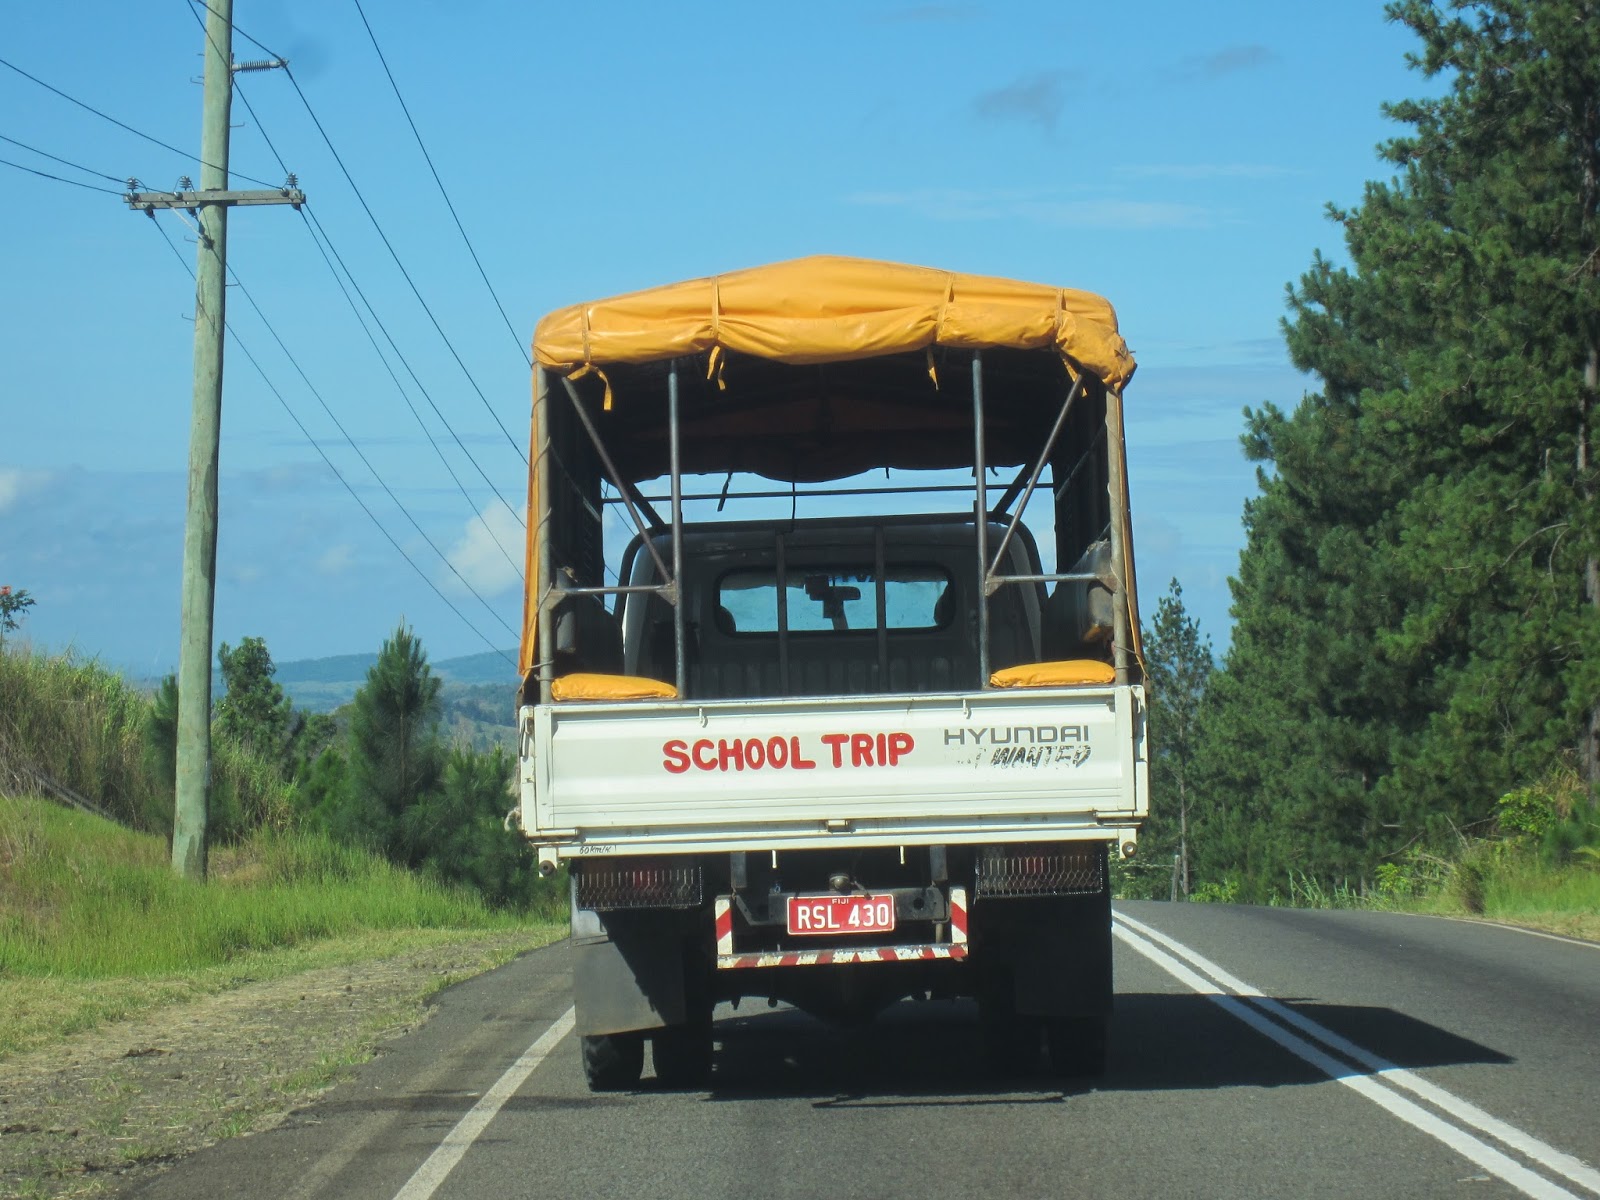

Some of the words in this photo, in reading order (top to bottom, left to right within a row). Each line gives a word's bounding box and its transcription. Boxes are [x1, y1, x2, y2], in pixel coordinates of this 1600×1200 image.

[944, 725, 1089, 745] HYUNDAI
[662, 738, 816, 774] SCHOOL
[821, 732, 915, 768] TRIP
[797, 904, 840, 930] RSL
[848, 903, 889, 928] 430
